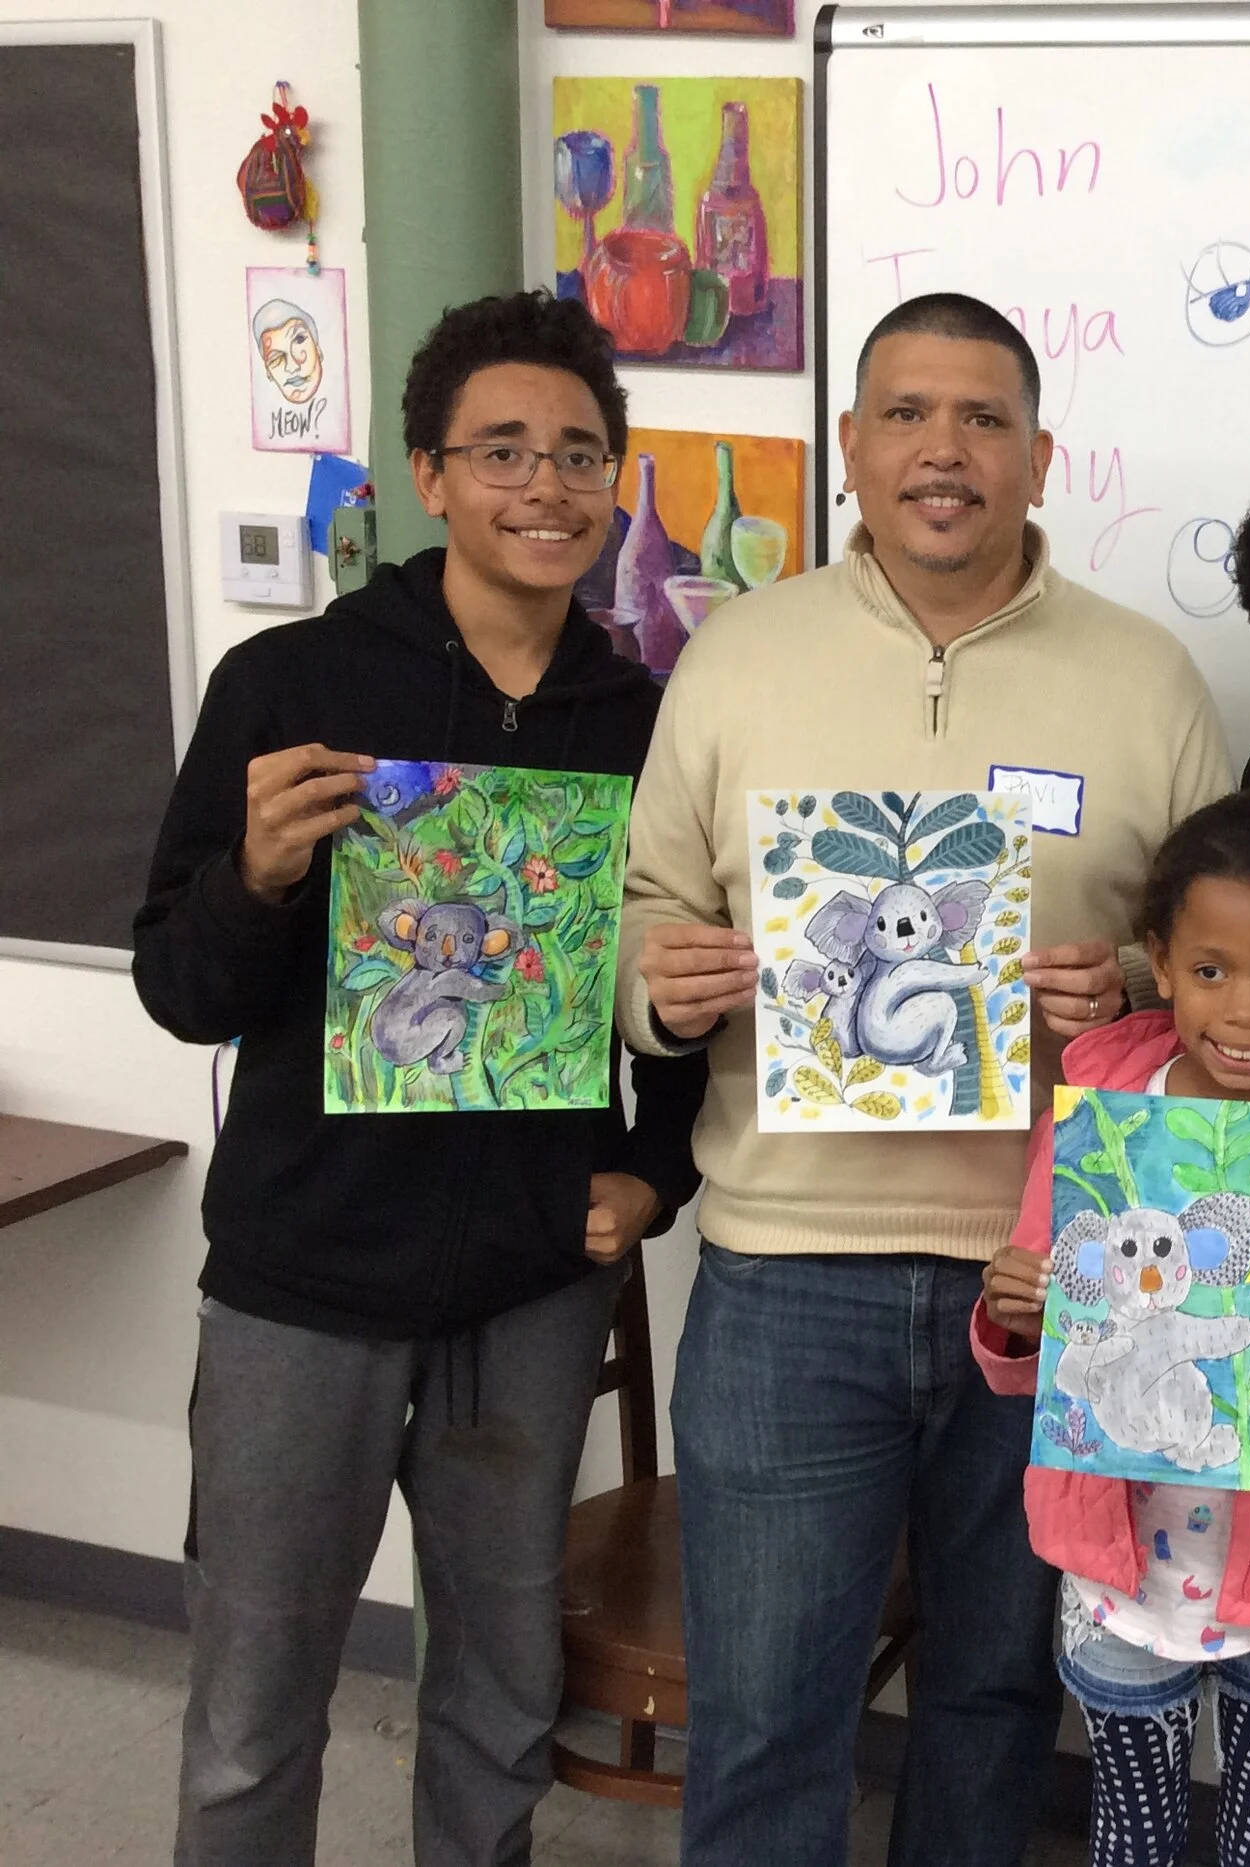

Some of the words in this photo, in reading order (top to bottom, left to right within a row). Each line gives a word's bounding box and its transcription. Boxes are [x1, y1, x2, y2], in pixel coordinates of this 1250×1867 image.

[896, 82, 1101, 208] John
[866, 248, 1124, 429] Tnya
[269, 397, 327, 440] MEOW?
